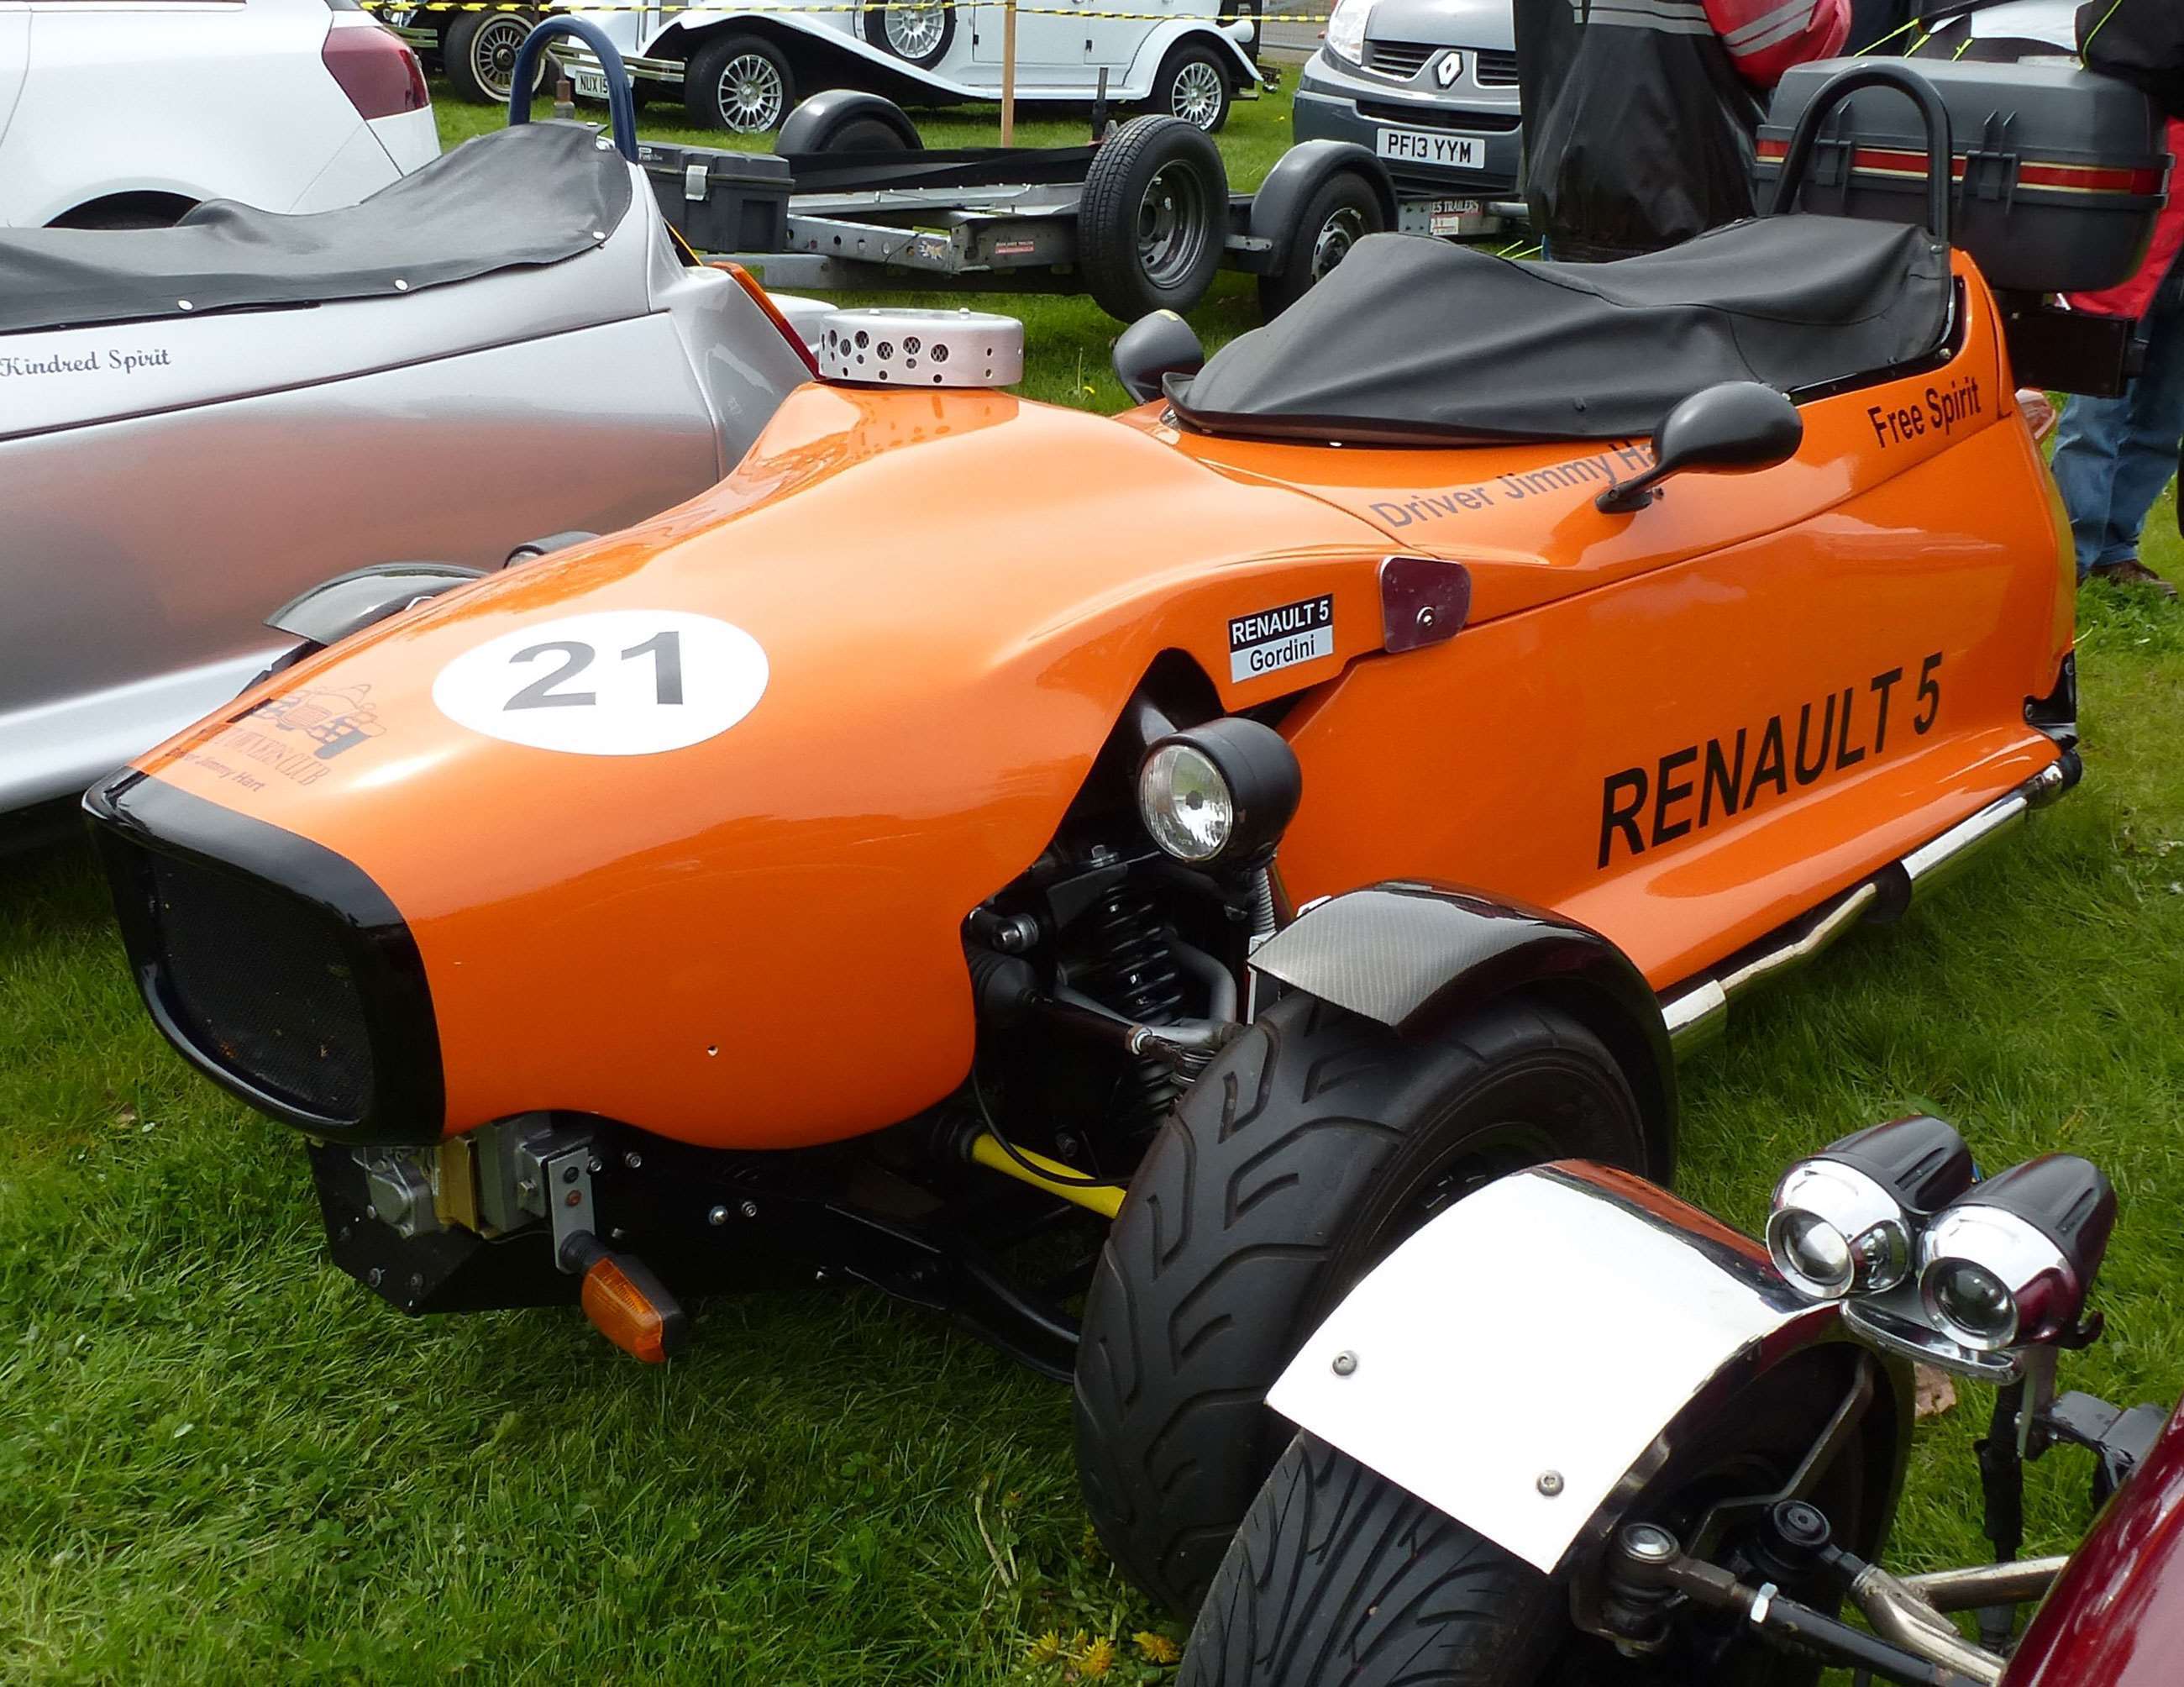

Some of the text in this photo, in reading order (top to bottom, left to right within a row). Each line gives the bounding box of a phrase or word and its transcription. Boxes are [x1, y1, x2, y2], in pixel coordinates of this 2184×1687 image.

[580, 75, 597, 92] NUX
[1388, 133, 1471, 164] PF13 YYM
[0, 349, 171, 376] Kindred Spirit
[1867, 376, 1981, 448] Free Spirit
[1369, 486, 1494, 528] Driver
[1496, 454, 1617, 499] Jimmy
[1231, 599, 1329, 645] RENAULT 5
[502, 630, 684, 712] 21
[1250, 633, 1315, 671] Gordini
[232, 771, 266, 792] Hart
[1597, 651, 1943, 870] RENAULT 5
